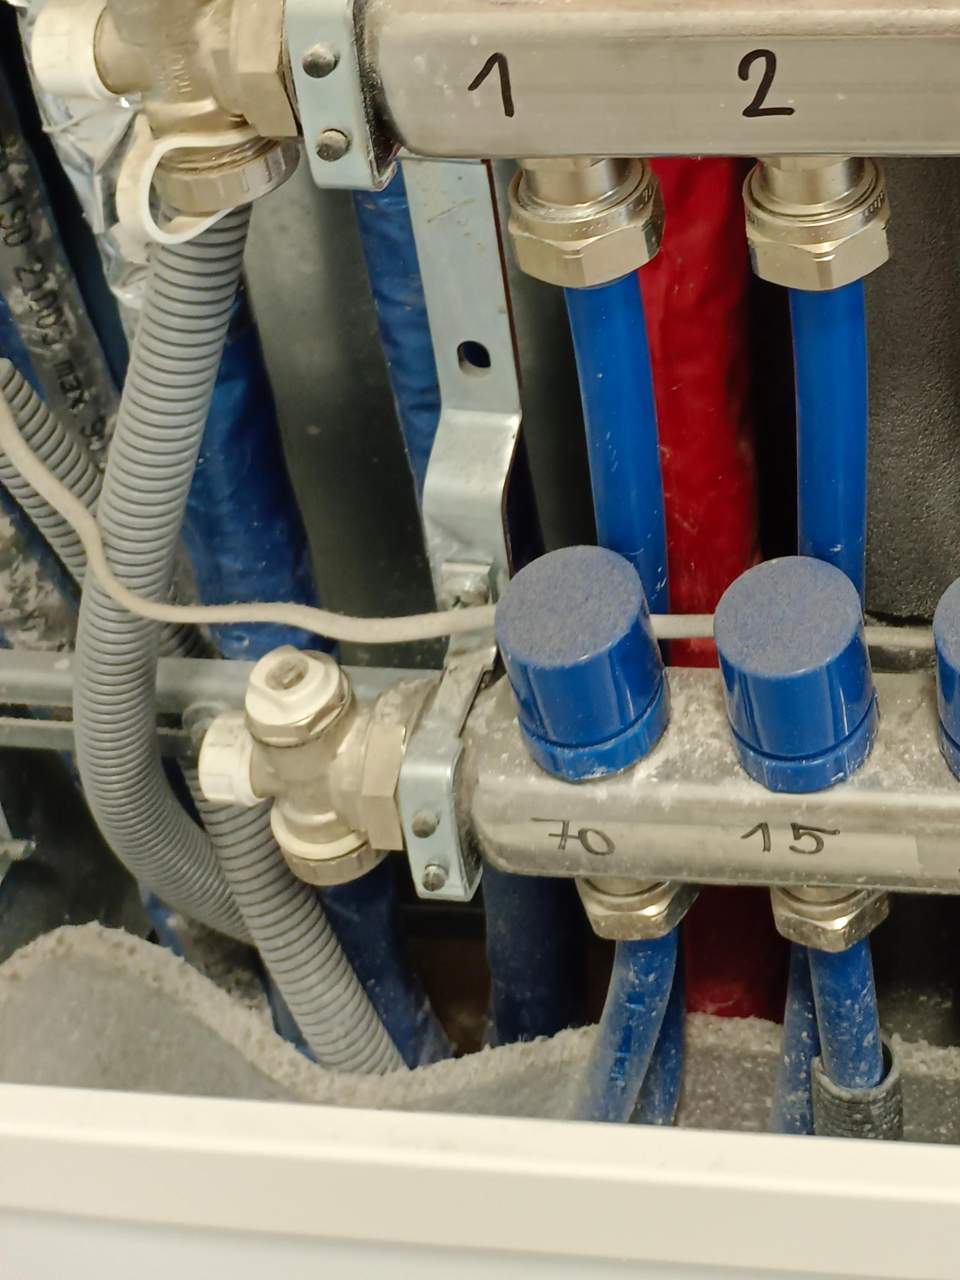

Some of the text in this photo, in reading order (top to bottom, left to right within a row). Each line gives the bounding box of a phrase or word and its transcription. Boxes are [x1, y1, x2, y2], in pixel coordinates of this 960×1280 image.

[467, 51, 514, 118] 1
[737, 49, 795, 118] 2
[530, 817, 615, 856] 70
[739, 821, 841, 855] 15
